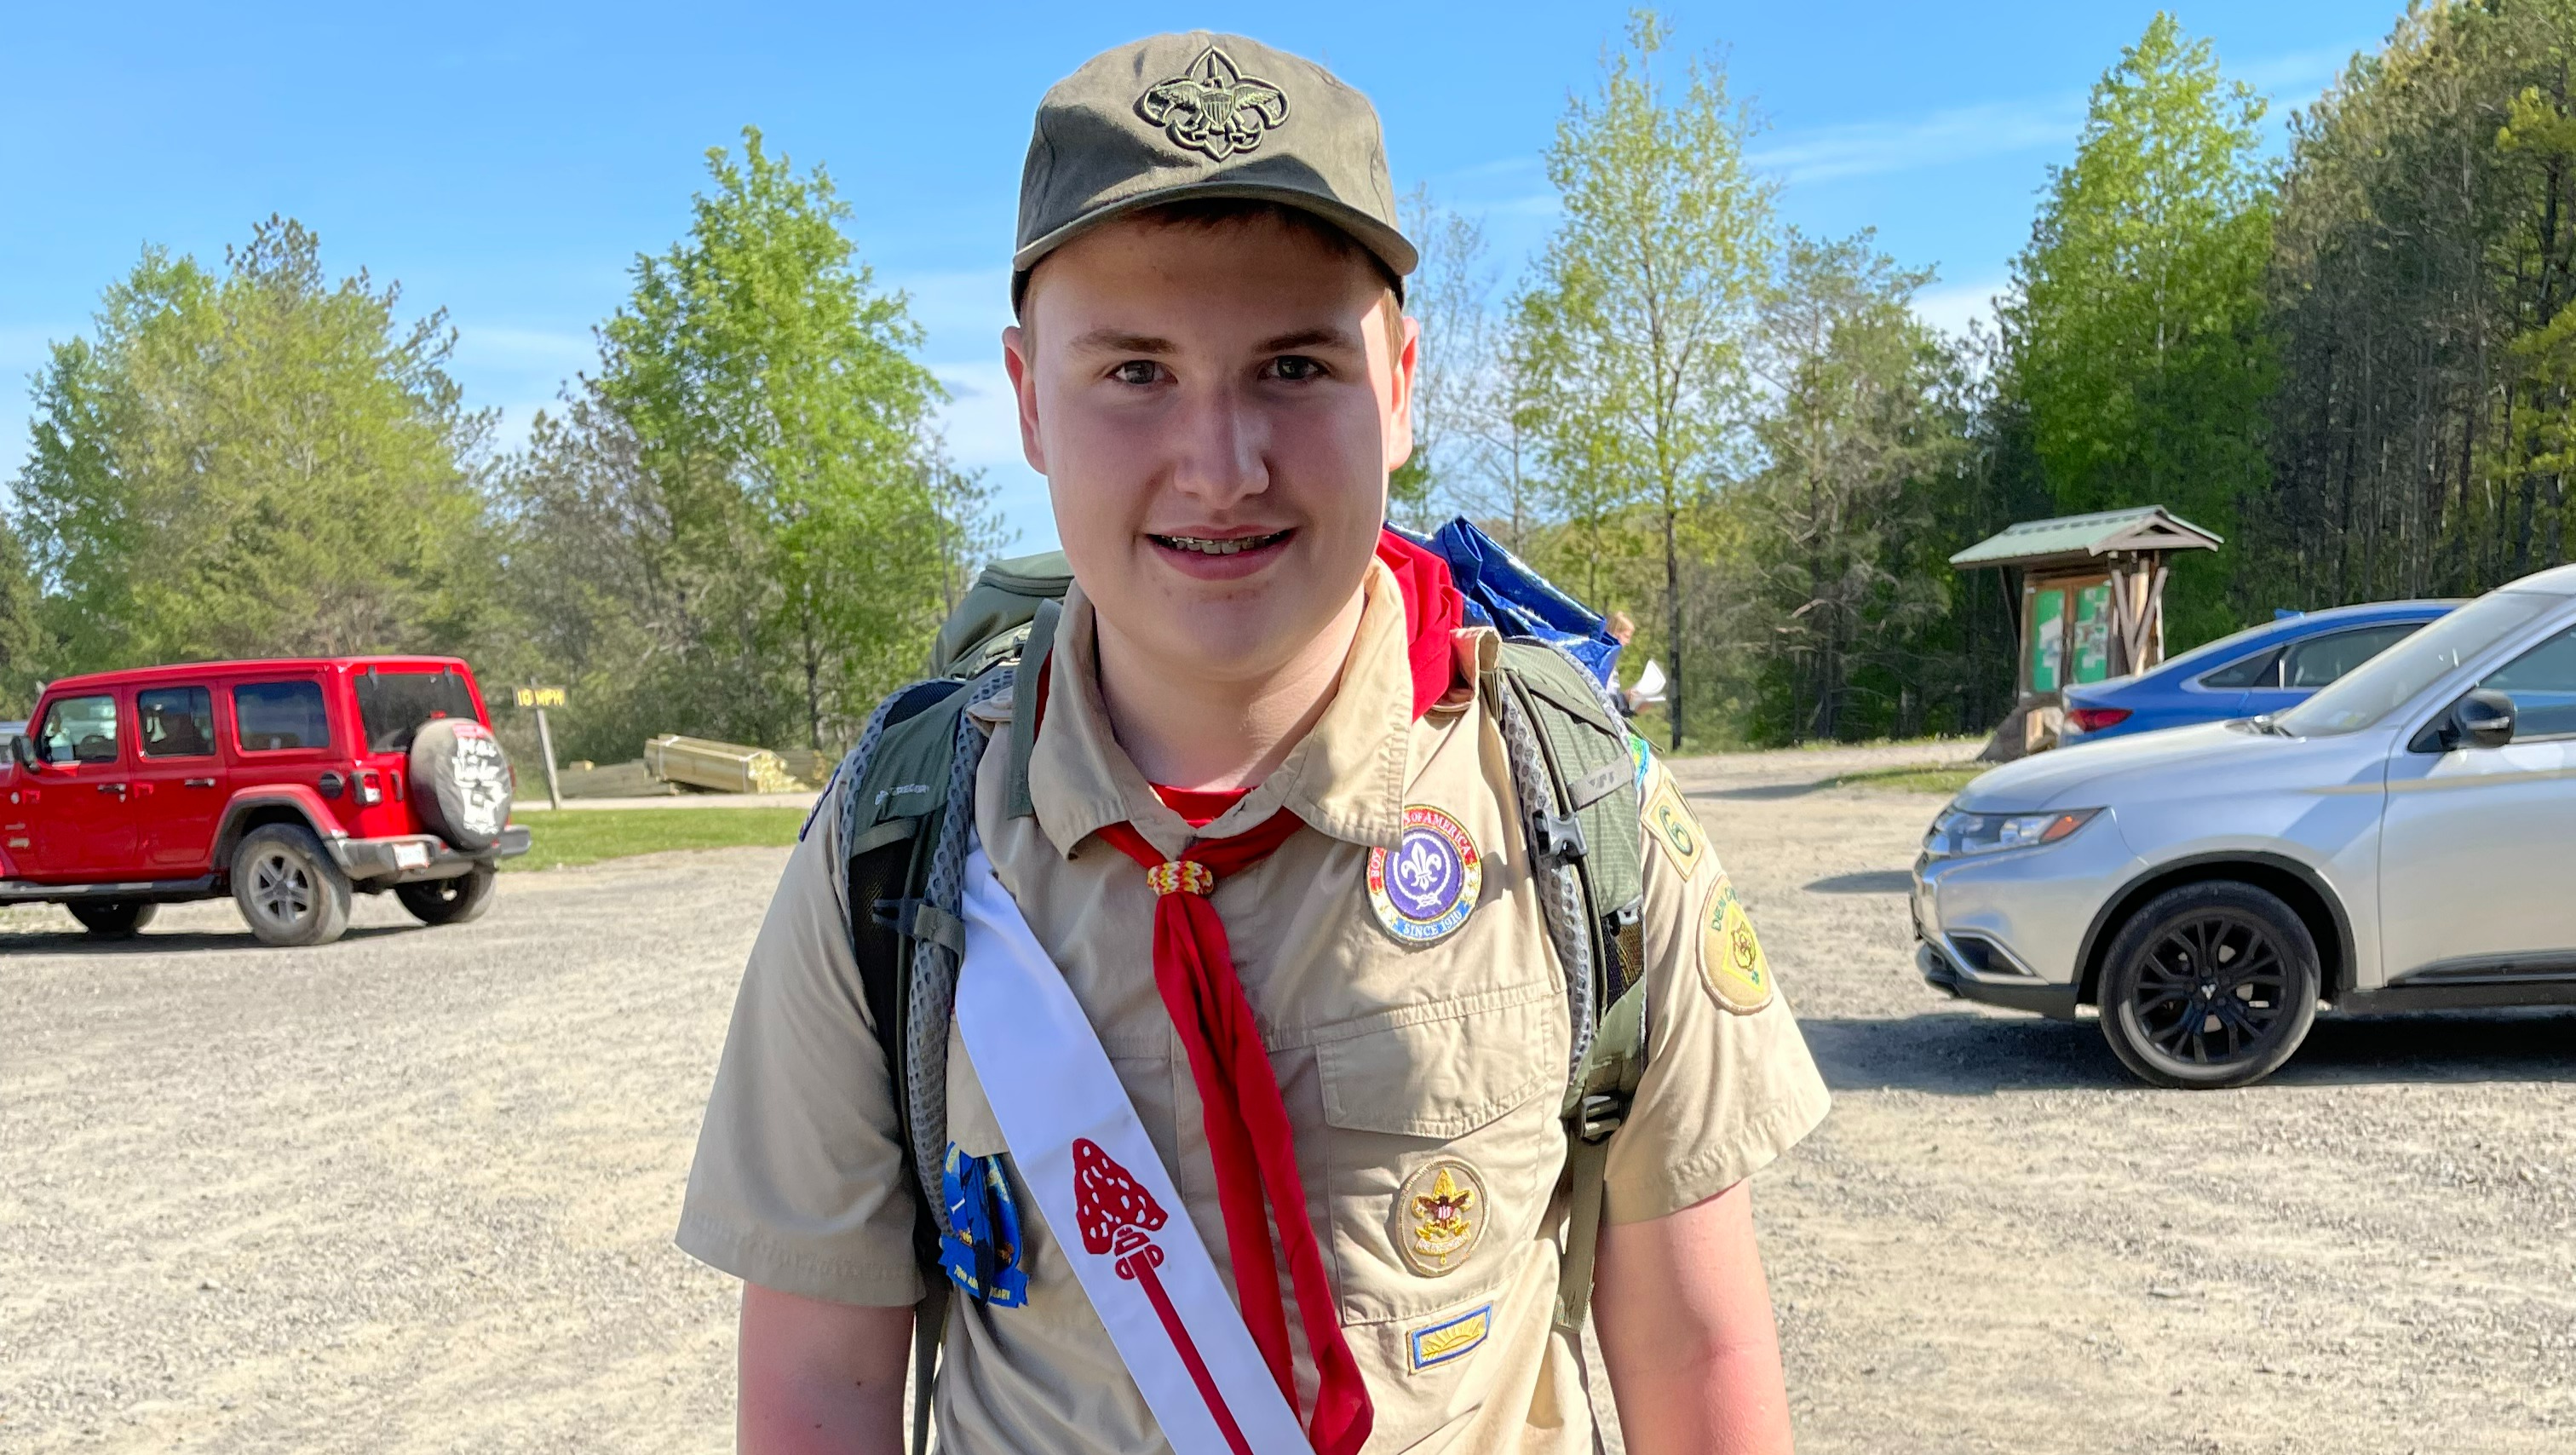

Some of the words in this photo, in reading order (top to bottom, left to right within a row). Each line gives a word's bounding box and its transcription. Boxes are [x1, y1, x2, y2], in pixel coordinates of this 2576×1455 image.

[517, 688, 533, 706] 10
[534, 688, 565, 706] MPH
[1411, 812, 1423, 823] OF
[1423, 811, 1471, 856] AMERICA
[1659, 805, 1693, 856] 6
[1404, 923, 1440, 937] SINCE
[1440, 911, 1463, 931] 1910
